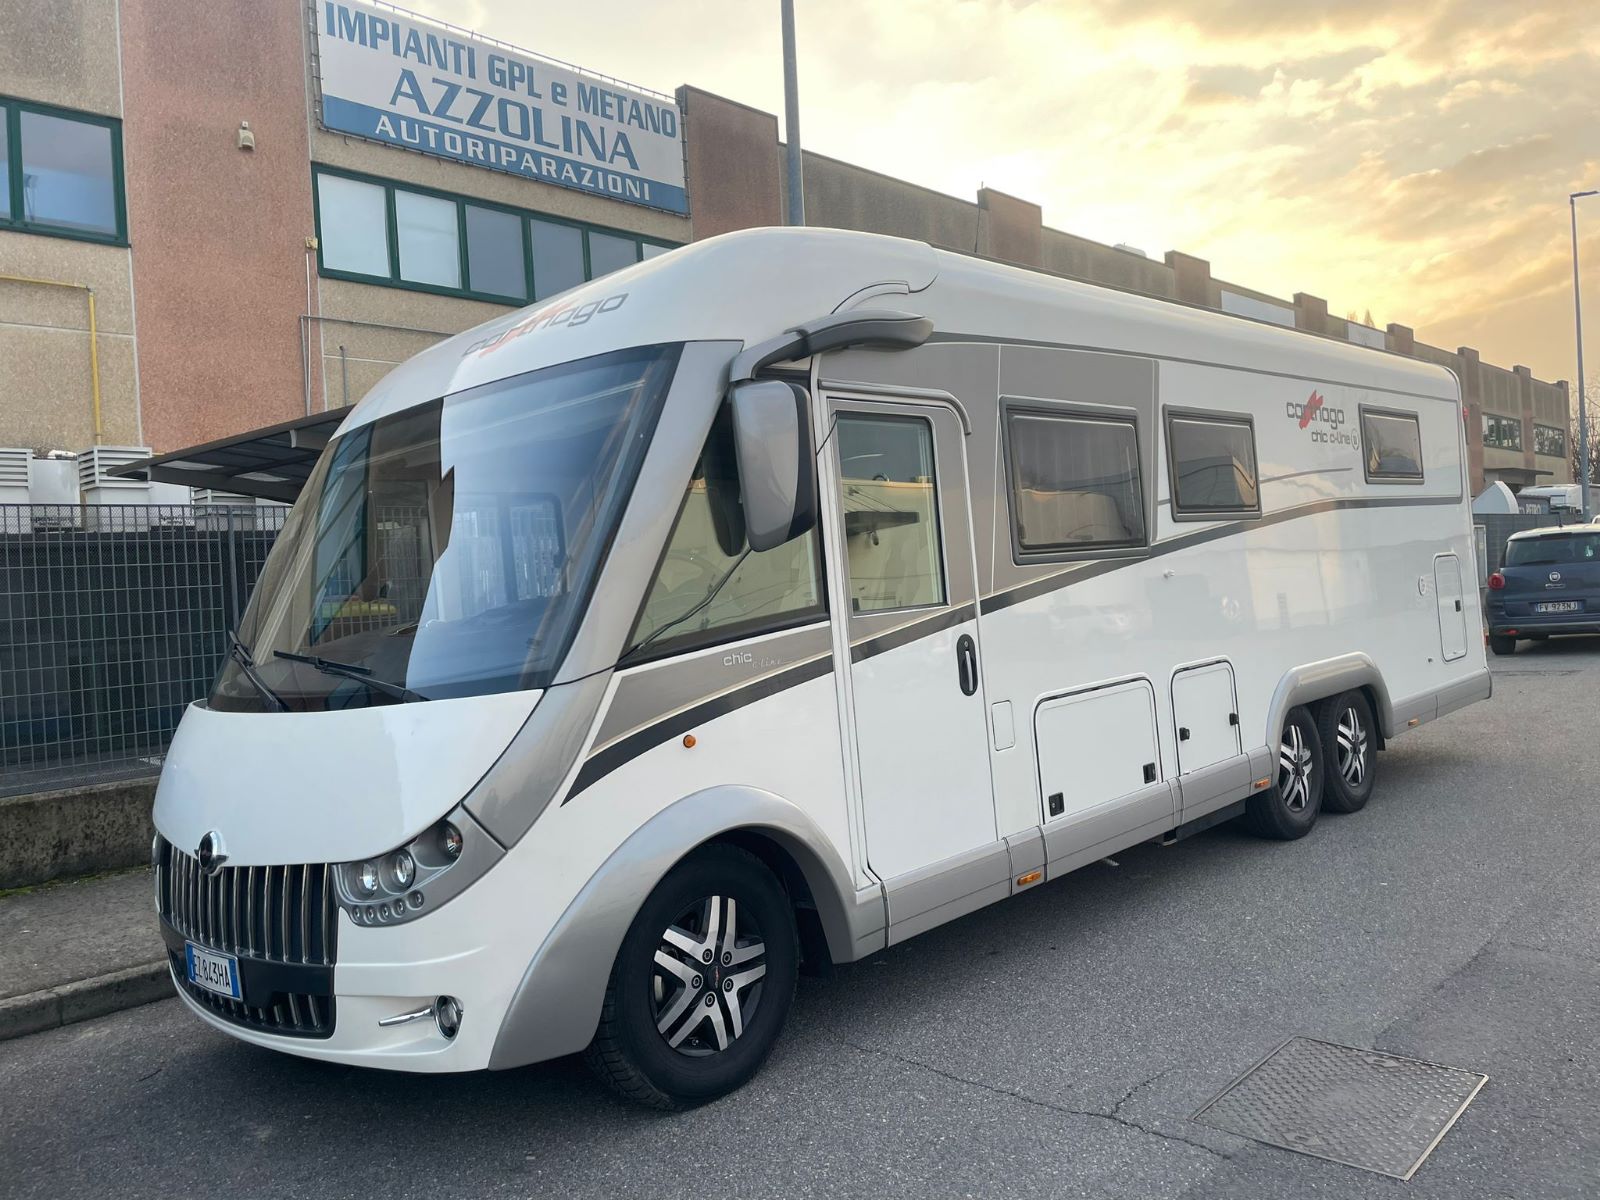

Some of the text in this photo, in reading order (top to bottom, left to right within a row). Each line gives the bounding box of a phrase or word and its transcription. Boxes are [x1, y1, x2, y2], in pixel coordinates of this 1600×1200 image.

[325, 2, 677, 139] IMPIANTI GPL e METANO
[375, 115, 650, 201] AUTORIPARAZIONI
[389, 68, 640, 171] AZZOLINA
[723, 652, 752, 666] chic
